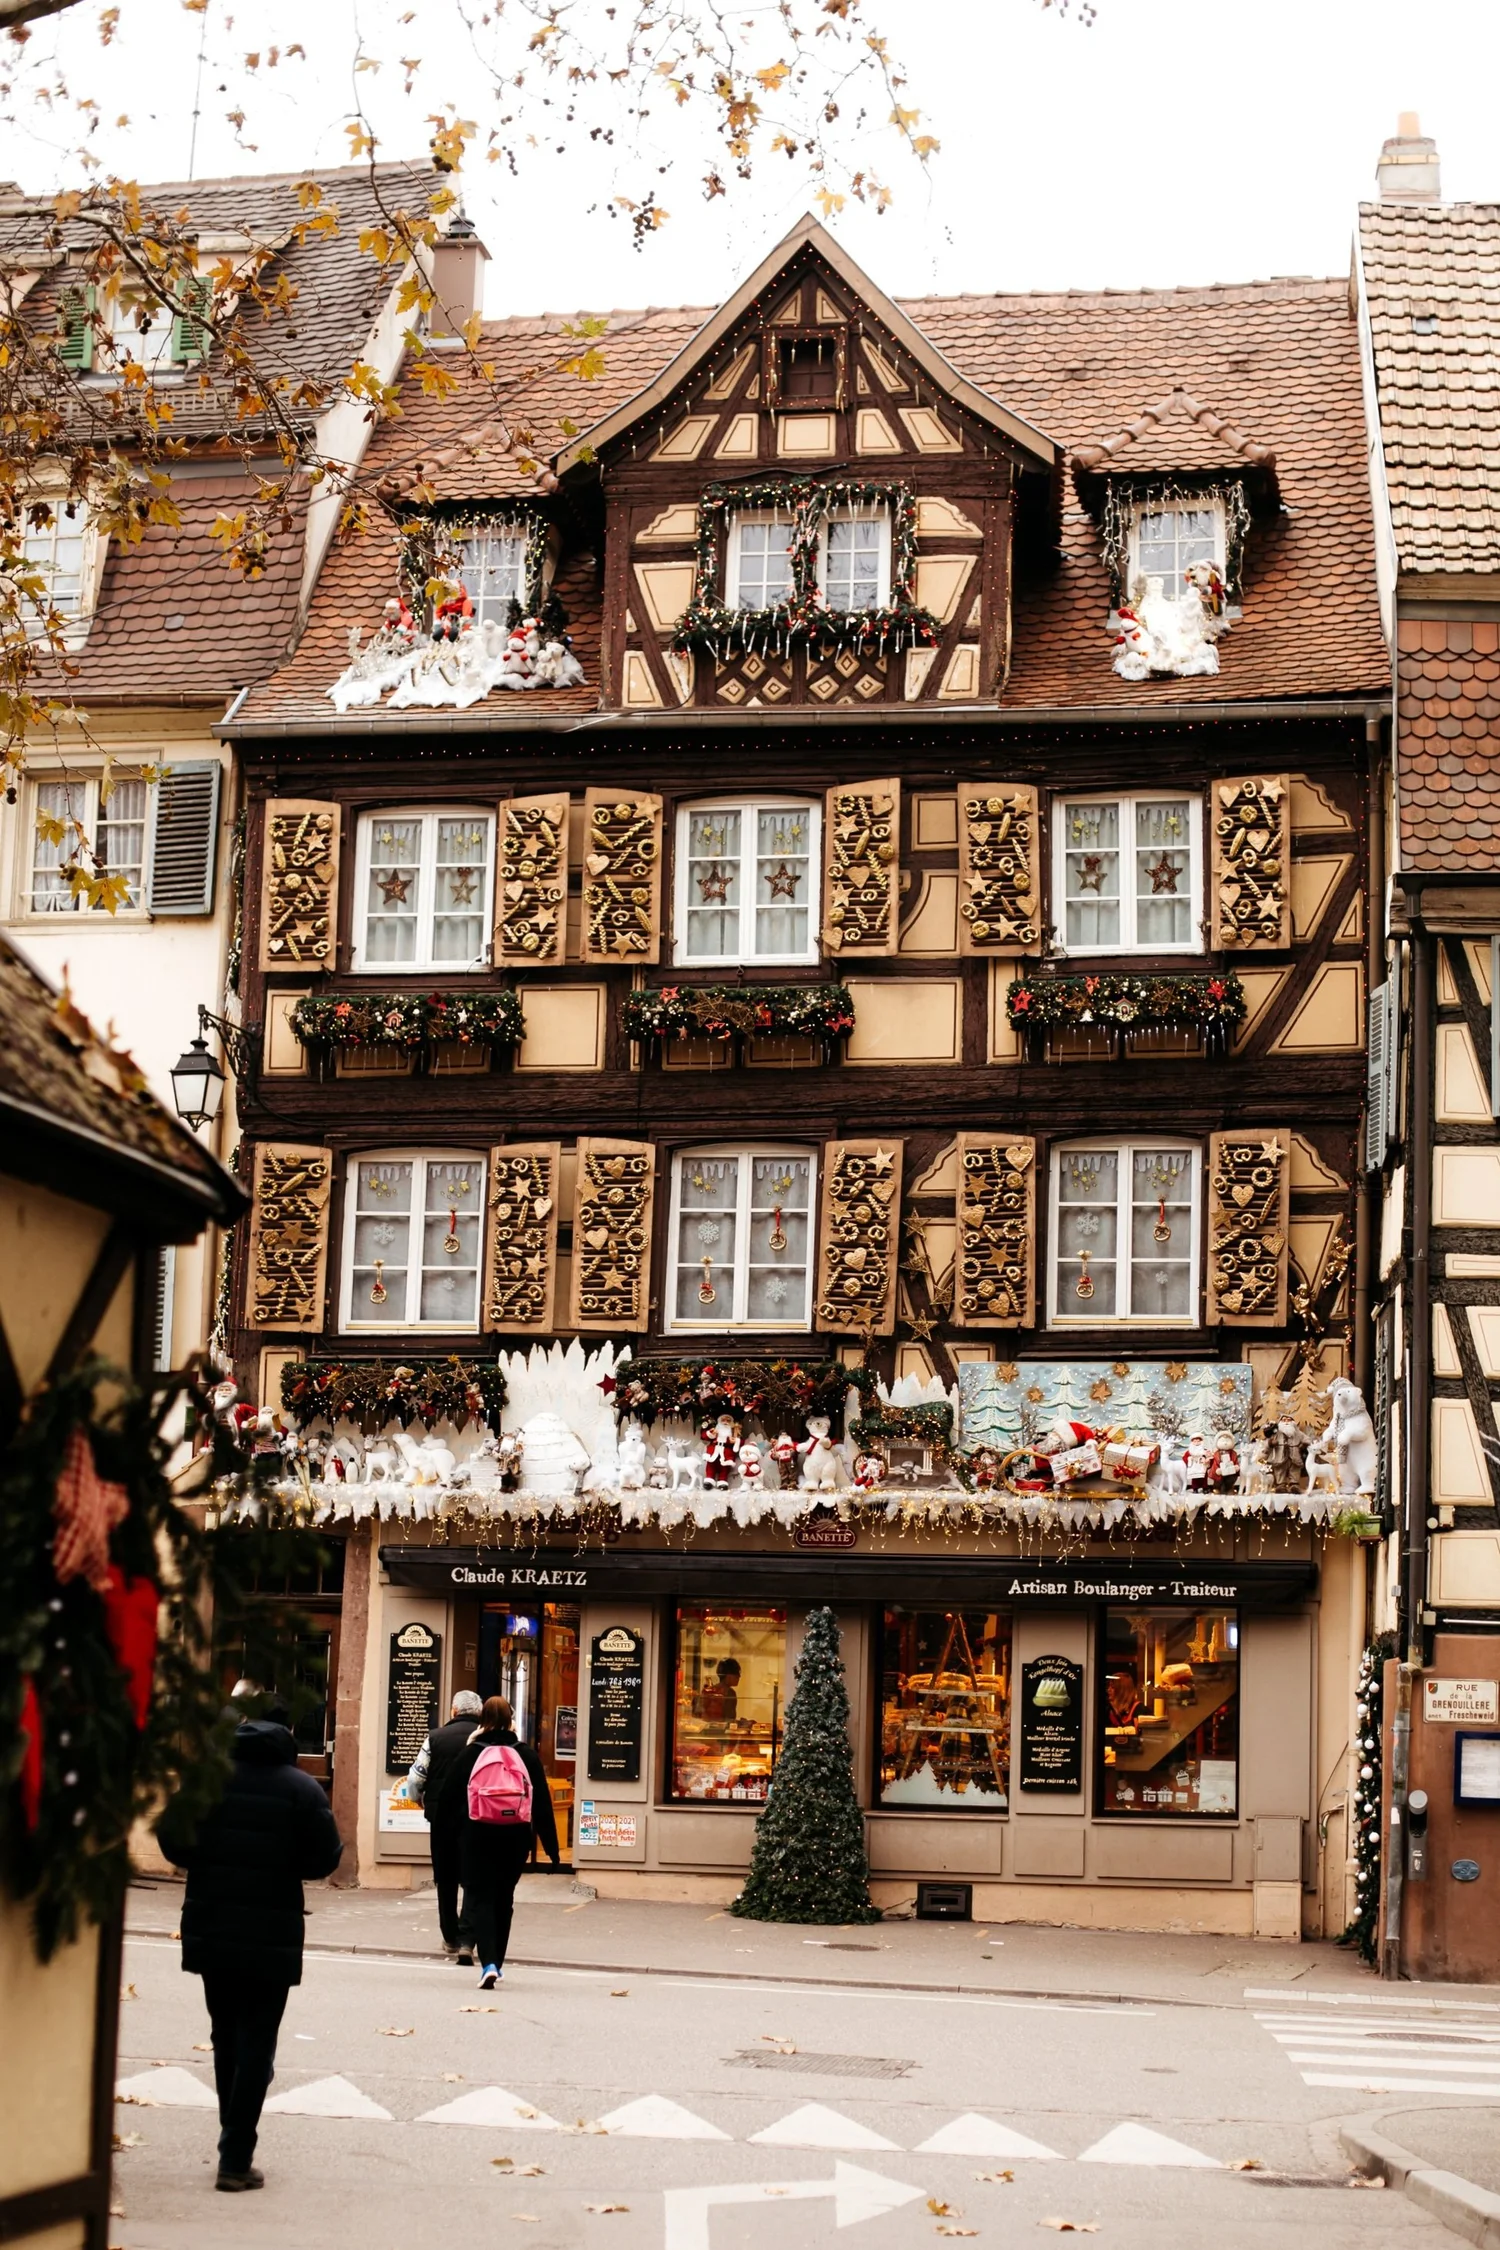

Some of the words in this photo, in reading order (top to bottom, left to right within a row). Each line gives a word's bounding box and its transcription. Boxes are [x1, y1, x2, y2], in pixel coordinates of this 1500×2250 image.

[802, 1533, 850, 1541] BANETTE
[451, 1567, 505, 1585] Claude
[511, 1569, 587, 1586] KRAETZ
[1008, 1579, 1067, 1595] Artisan
[1074, 1580, 1154, 1600] Boulanger
[1170, 1581, 1237, 1597] Traiteur
[1456, 1684, 1478, 1692] RUE
[1432, 1700, 1490, 1710] GRENOUILLERE
[1449, 1711, 1494, 1719] Frescheweid
[619, 1817, 635, 1825] 2021
